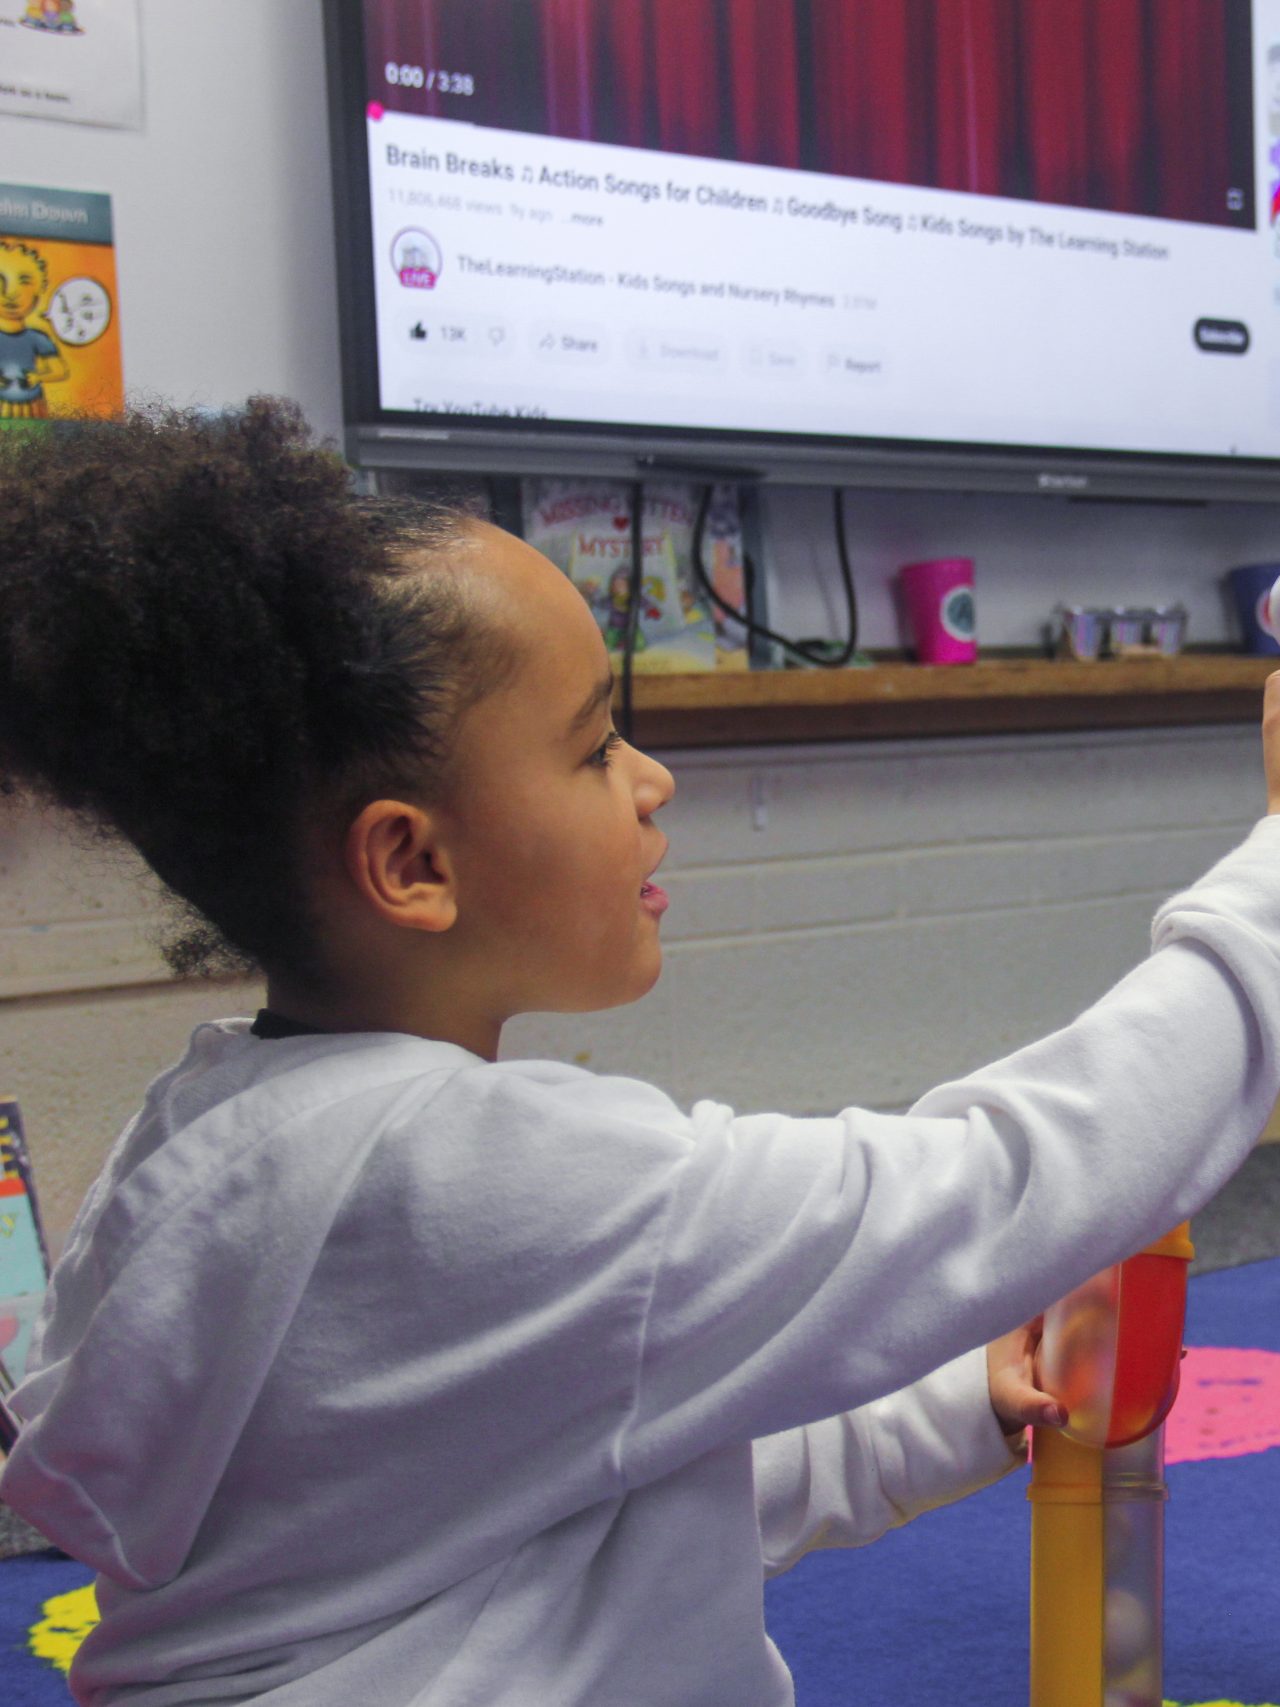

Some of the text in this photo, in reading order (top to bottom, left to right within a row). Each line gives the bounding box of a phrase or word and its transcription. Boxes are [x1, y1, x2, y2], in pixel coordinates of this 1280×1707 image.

[385, 61, 424, 88] 0:00
[386, 144, 1168, 260] Brain Breaks Action Songs for Children Goodbye Song Kids Songs by The Learning Station
[466, 200, 503, 216] views
[457, 255, 606, 286] TheLearningStation
[617, 272, 649, 291] Kids
[653, 276, 696, 297] Songs
[700, 283, 725, 298] and
[729, 284, 780, 306] Nursery
[784, 287, 835, 309] Rhymes
[560, 336, 598, 352] Share
